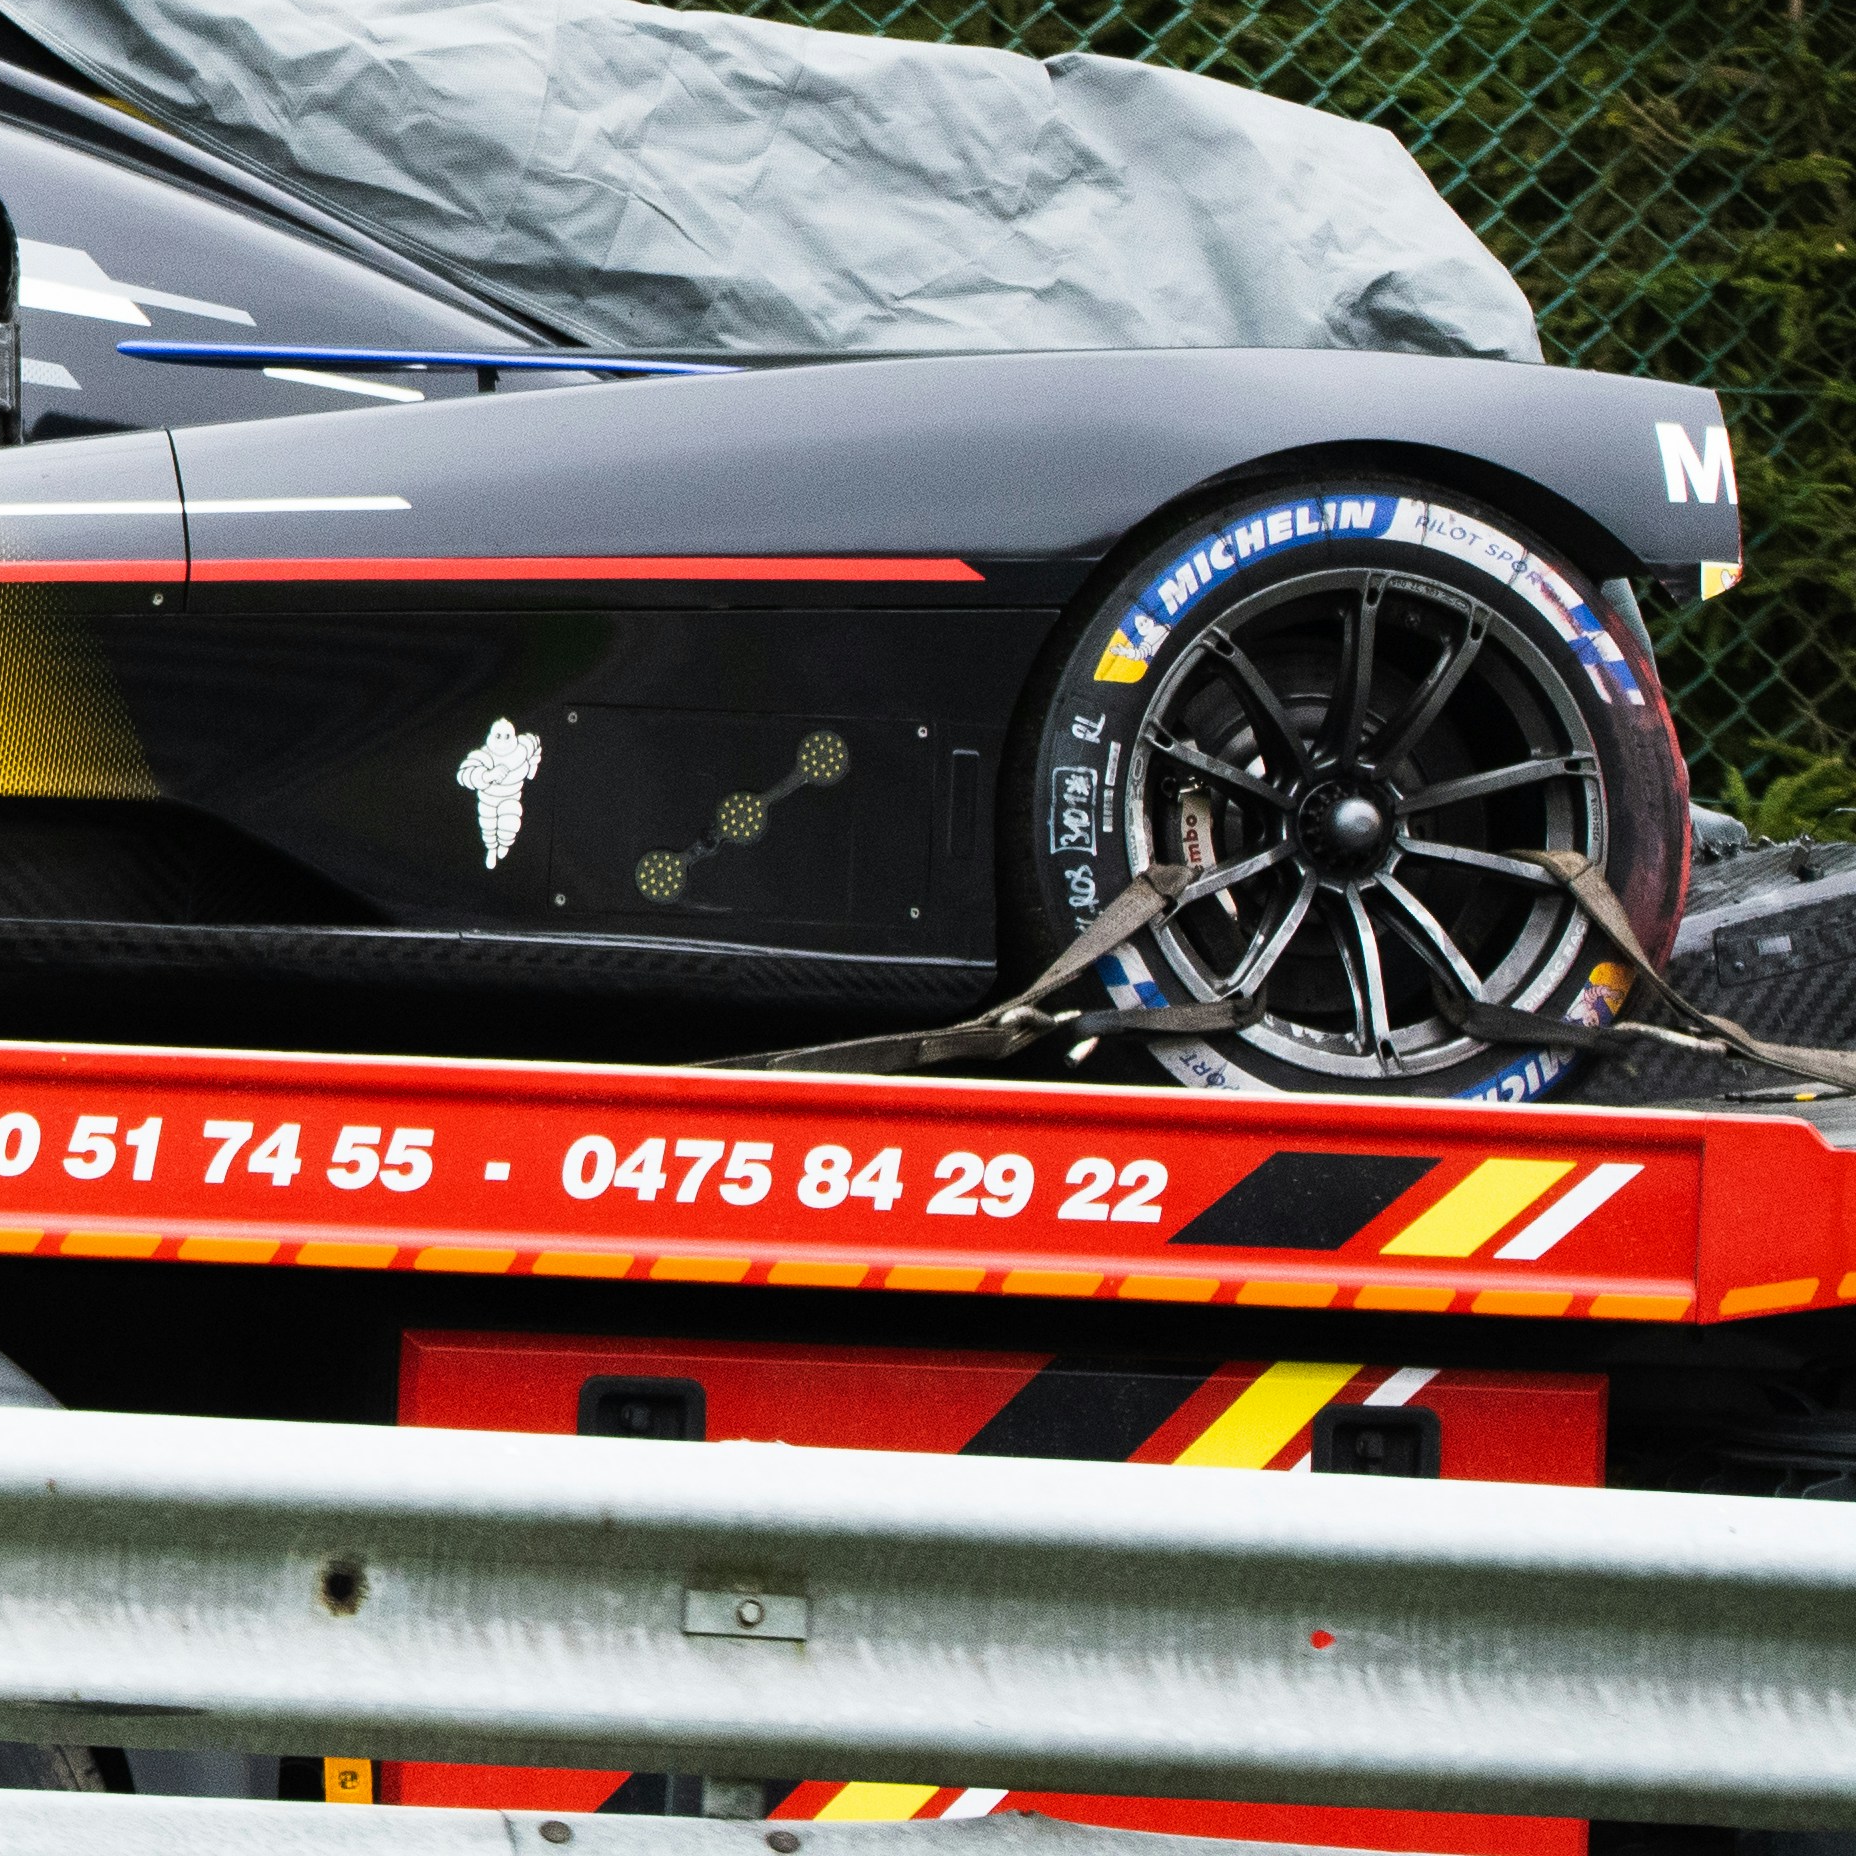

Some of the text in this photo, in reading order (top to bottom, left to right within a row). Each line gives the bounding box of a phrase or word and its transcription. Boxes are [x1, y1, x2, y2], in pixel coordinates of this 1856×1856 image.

[1157, 501, 1377, 616] MICHELIN
[1415, 514, 1481, 547] PILOT
[62, 1114, 163, 1182] 51
[202, 1120, 303, 1187] 74
[326, 1125, 435, 1192] 55
[483, 1161, 511, 1181] -
[561, 1135, 775, 1207] 0475
[797, 1144, 904, 1211] 84
[925, 1150, 1036, 1218] 29
[1057, 1156, 1170, 1224] 22
